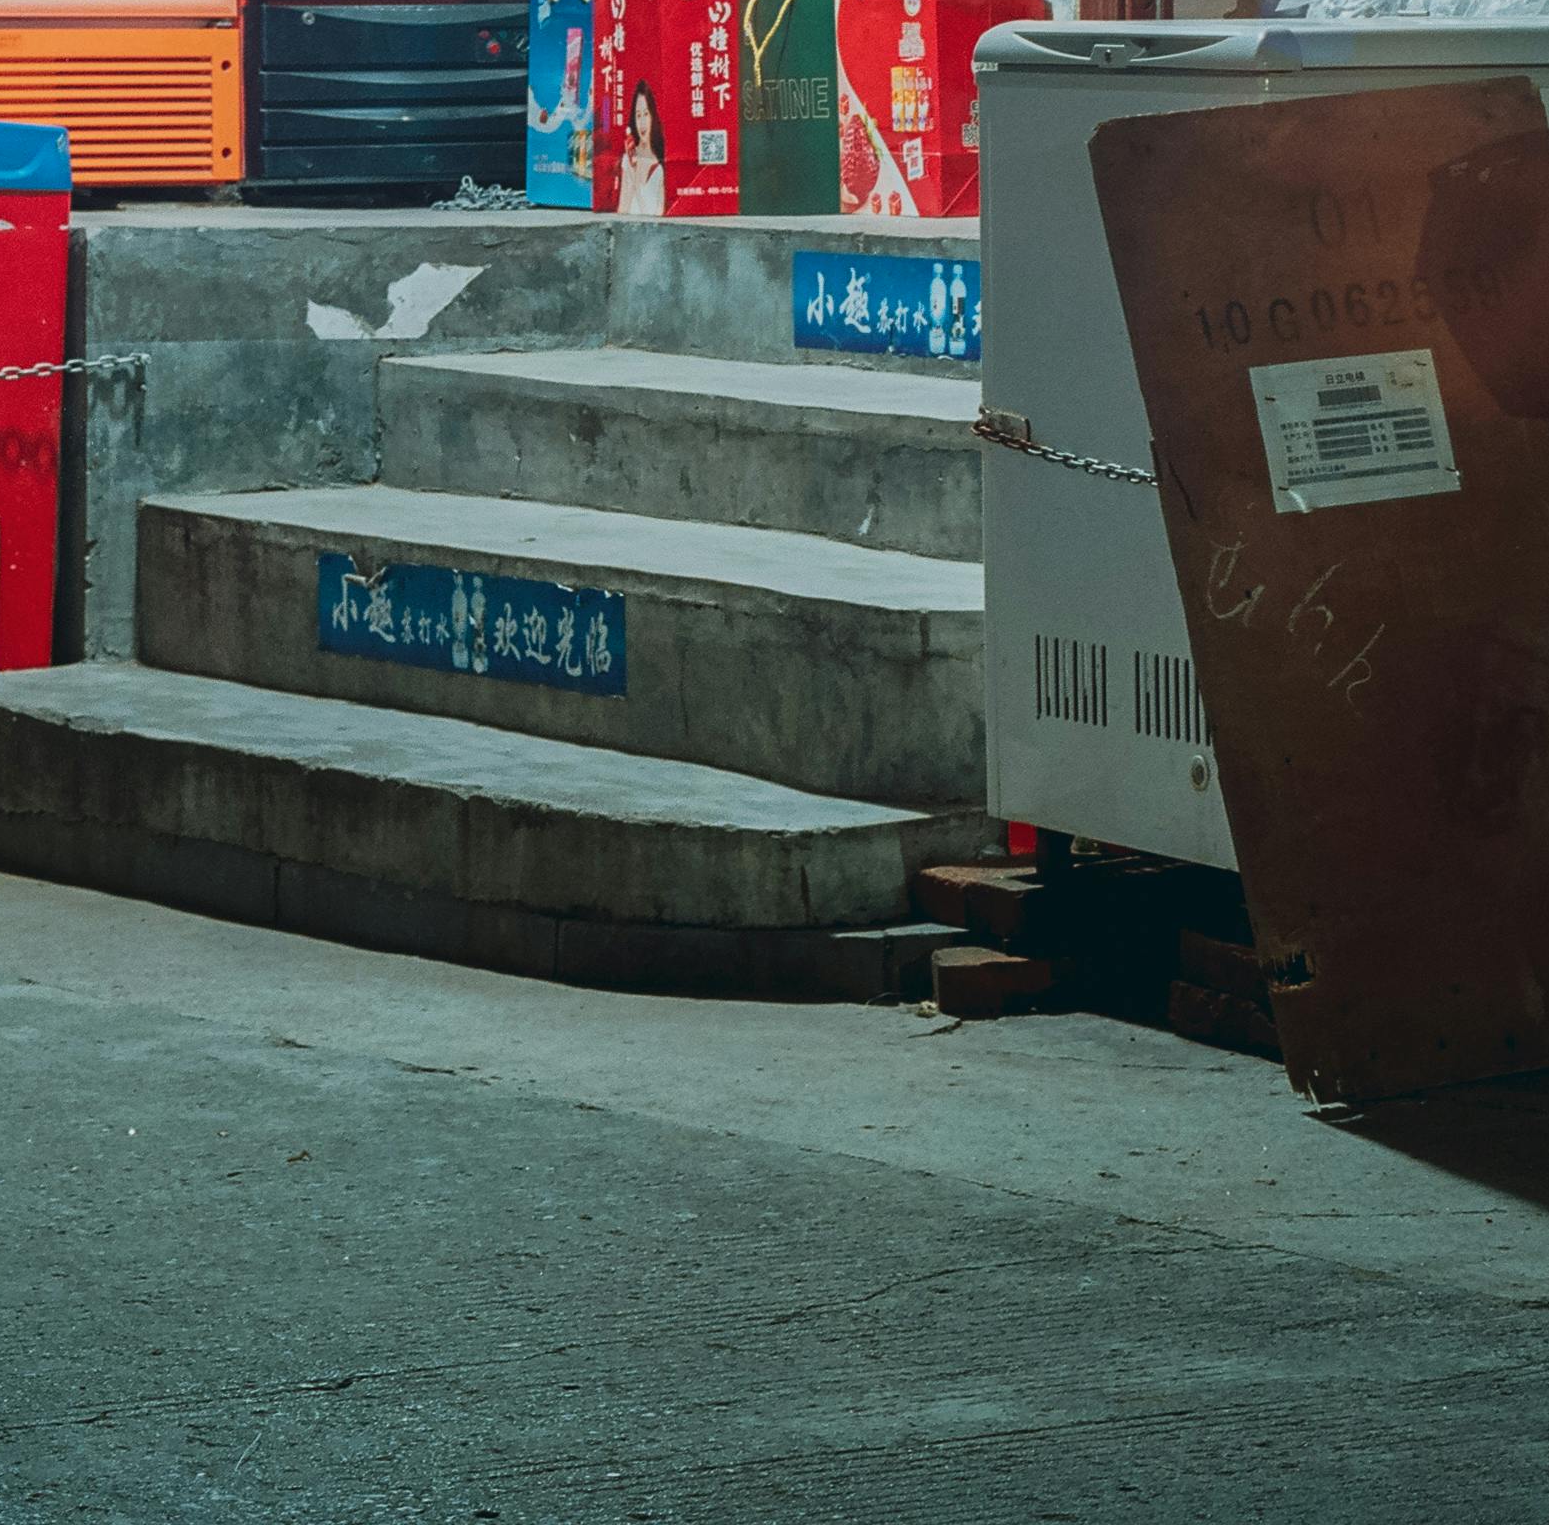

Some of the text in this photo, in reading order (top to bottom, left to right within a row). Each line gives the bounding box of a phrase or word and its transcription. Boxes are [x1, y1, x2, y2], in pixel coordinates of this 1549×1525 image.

[741, 77, 831, 121] SATINE
[494, 602, 612, 678] 欢迎光临
